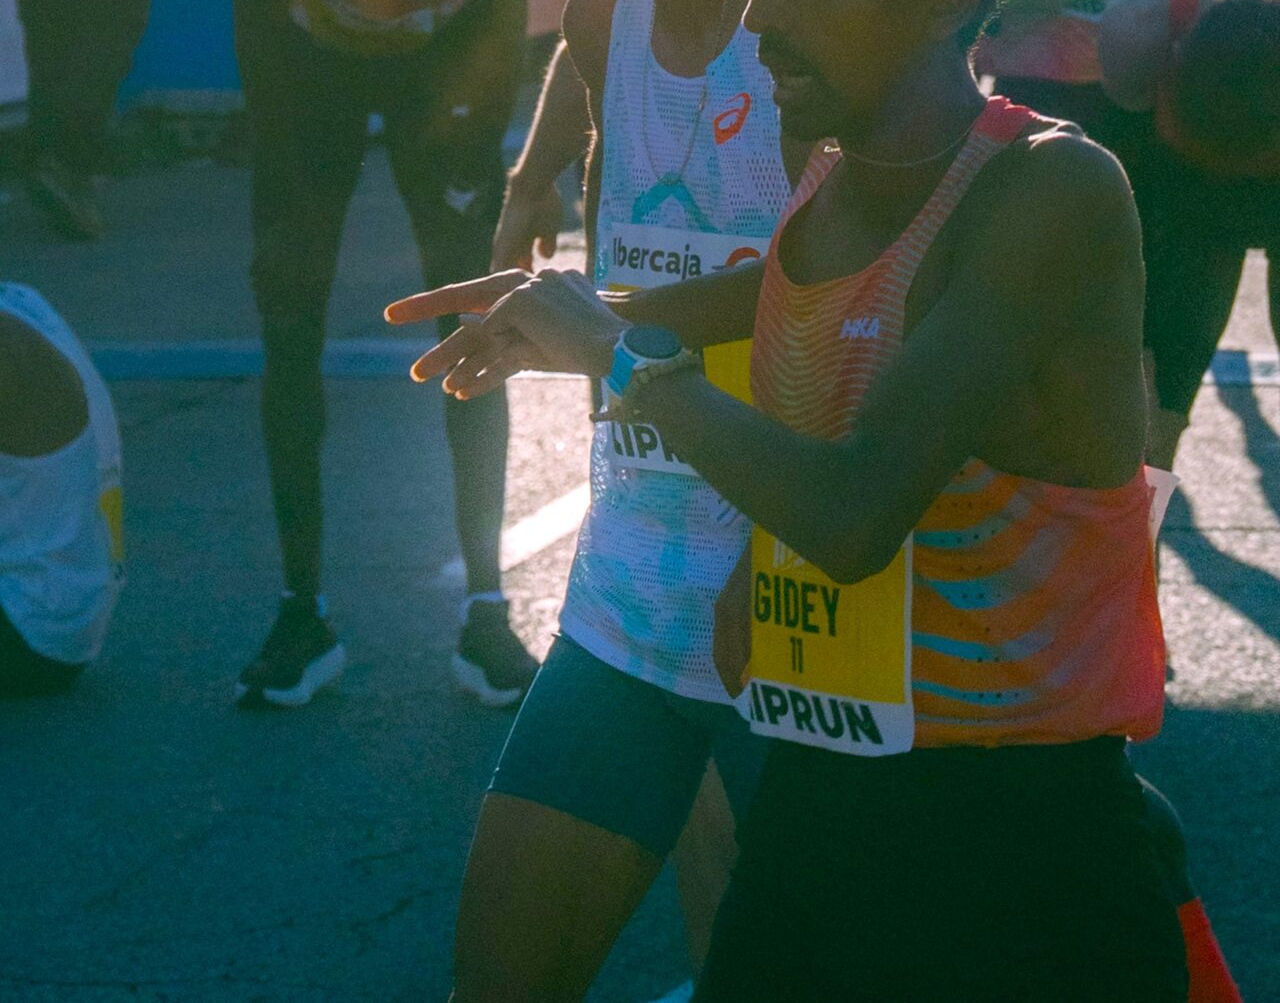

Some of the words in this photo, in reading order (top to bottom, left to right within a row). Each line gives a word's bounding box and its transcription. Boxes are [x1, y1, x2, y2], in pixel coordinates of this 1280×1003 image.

[612, 236, 702, 281] Ibercaja
[754, 571, 841, 637] GIDEY
[789, 636, 804, 674] 11
[749, 681, 884, 745] IPRUN
